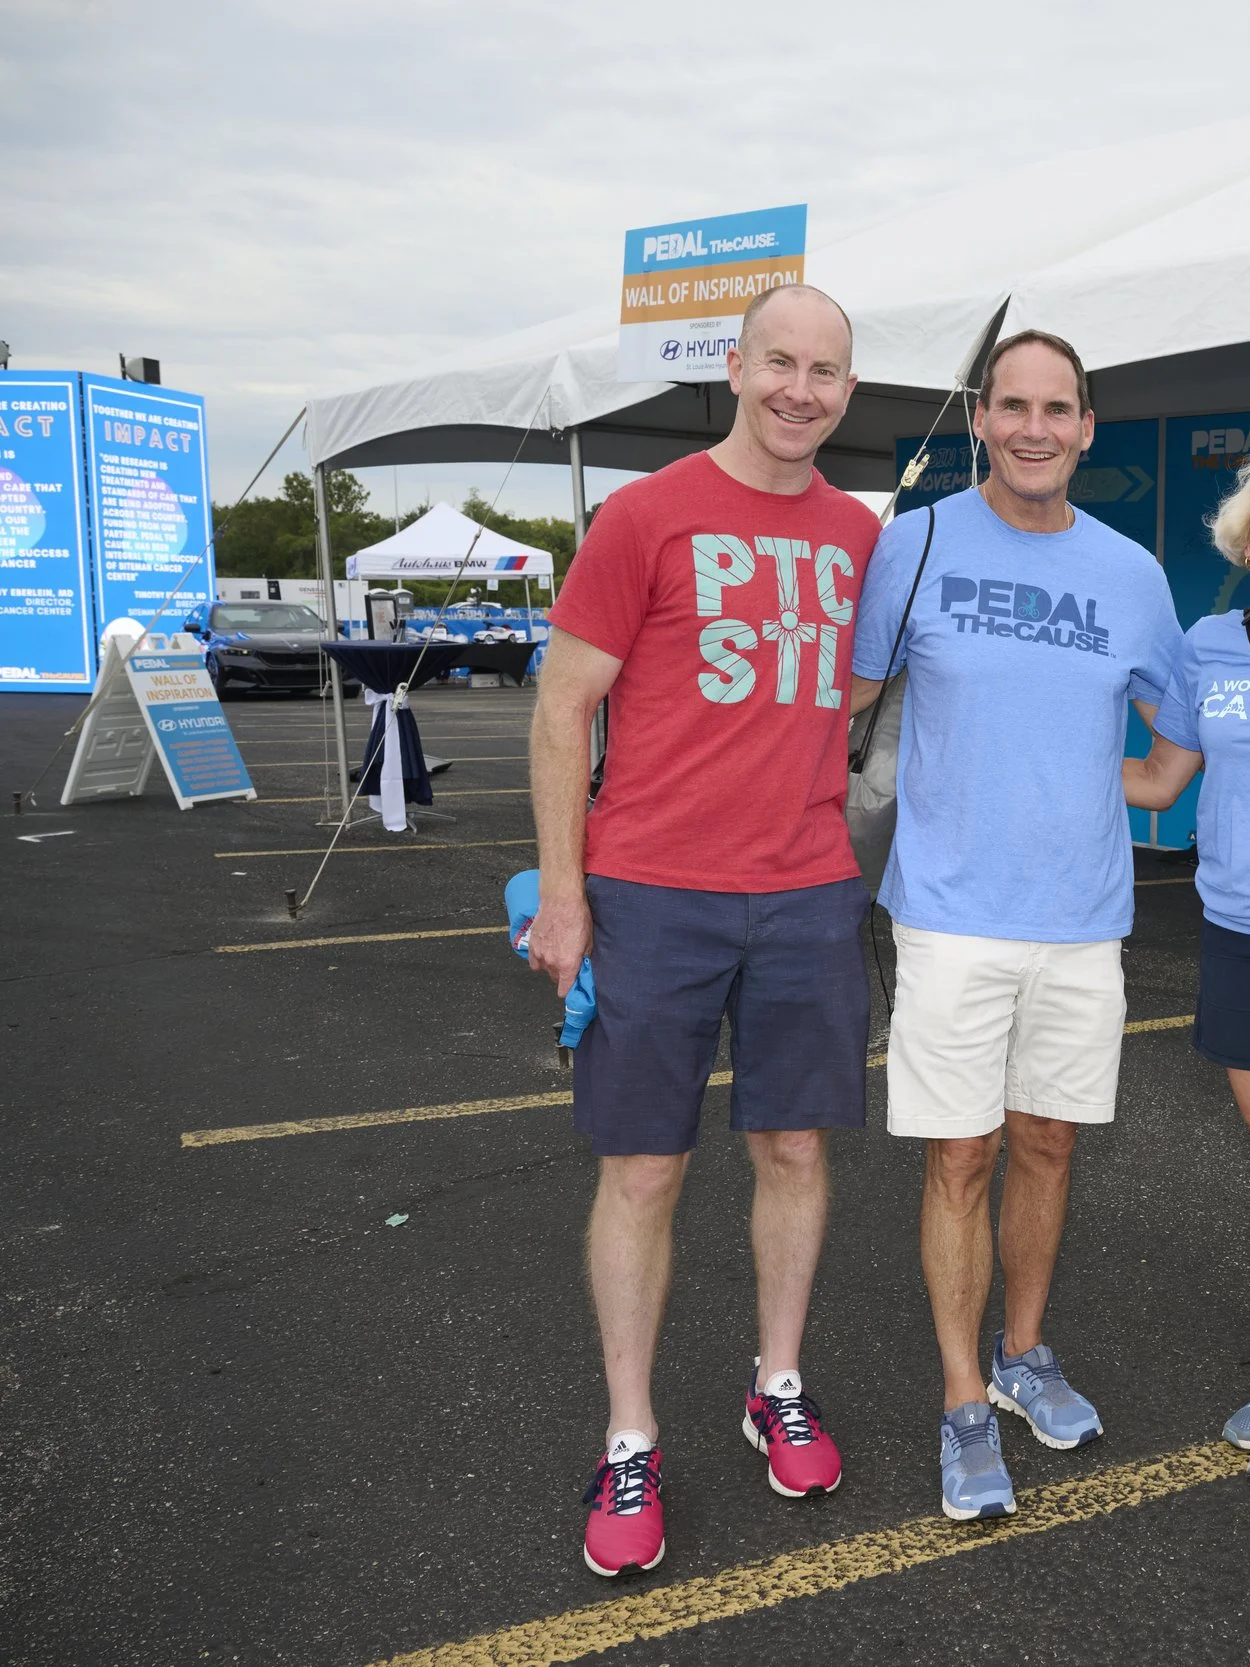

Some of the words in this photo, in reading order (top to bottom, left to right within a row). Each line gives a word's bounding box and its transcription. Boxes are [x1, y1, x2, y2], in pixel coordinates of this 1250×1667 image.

[643, 230, 708, 263] PEDAL
[625, 285, 665, 308] WALL
[668, 282, 689, 304] OF
[693, 270, 798, 301] INSPIRATION
[687, 338, 736, 358] HYUND
[11, 401, 67, 411] CREATING
[93, 404, 133, 419] TOGETHER
[104, 420, 191, 453] IMPACT
[4, 450, 15, 459] IS
[3, 483, 31, 491] CARE
[34, 483, 63, 492] THAT
[10, 527, 30, 535] THE
[19, 549, 70, 558] SUCCESS
[454, 560, 487, 568] BMW
[692, 534, 854, 625] PTC
[37, 607, 72, 615] CENTER
[940, 576, 1109, 638] PEDAL
[151, 674, 183, 686] WALL
[183, 674, 197, 684] OF
[1208, 681, 1218, 693] A
[146, 687, 213, 701] INSPIRATION
[178, 716, 226, 729] HYUNDAI
